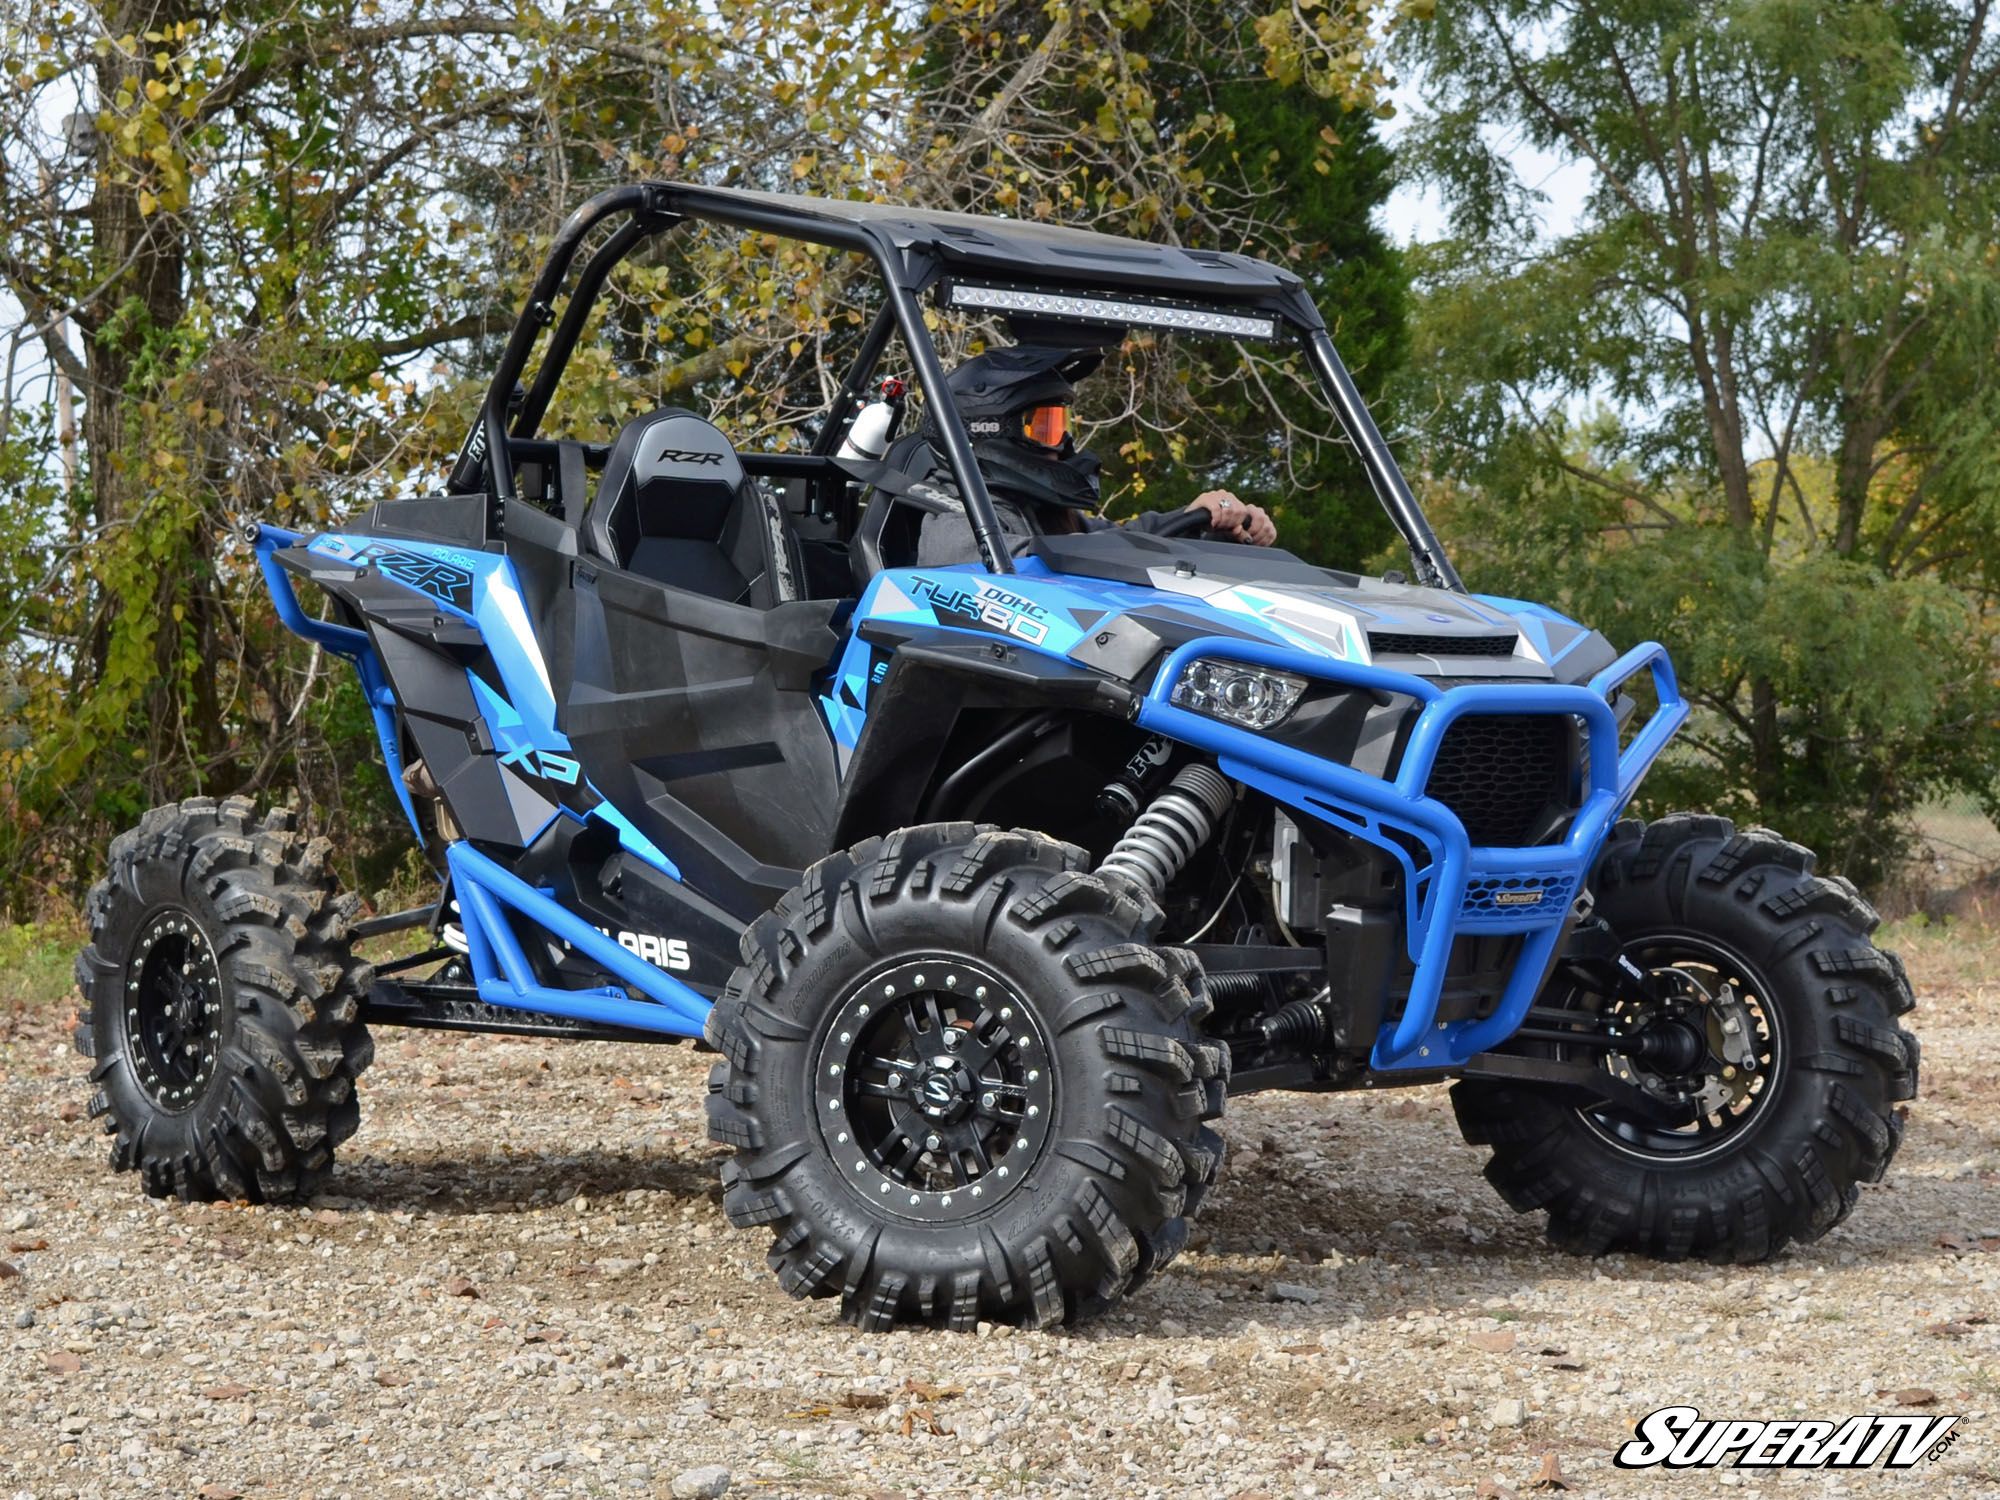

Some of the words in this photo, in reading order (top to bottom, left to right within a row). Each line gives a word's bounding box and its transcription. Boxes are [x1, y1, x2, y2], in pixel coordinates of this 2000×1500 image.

[970, 421, 1000, 434] 509
[656, 449, 725, 466] RZR
[349, 542, 471, 602] RZR
[432, 547, 477, 569] POLARIS
[908, 574, 1051, 647] TURBO
[983, 586, 1048, 620] DOHC
